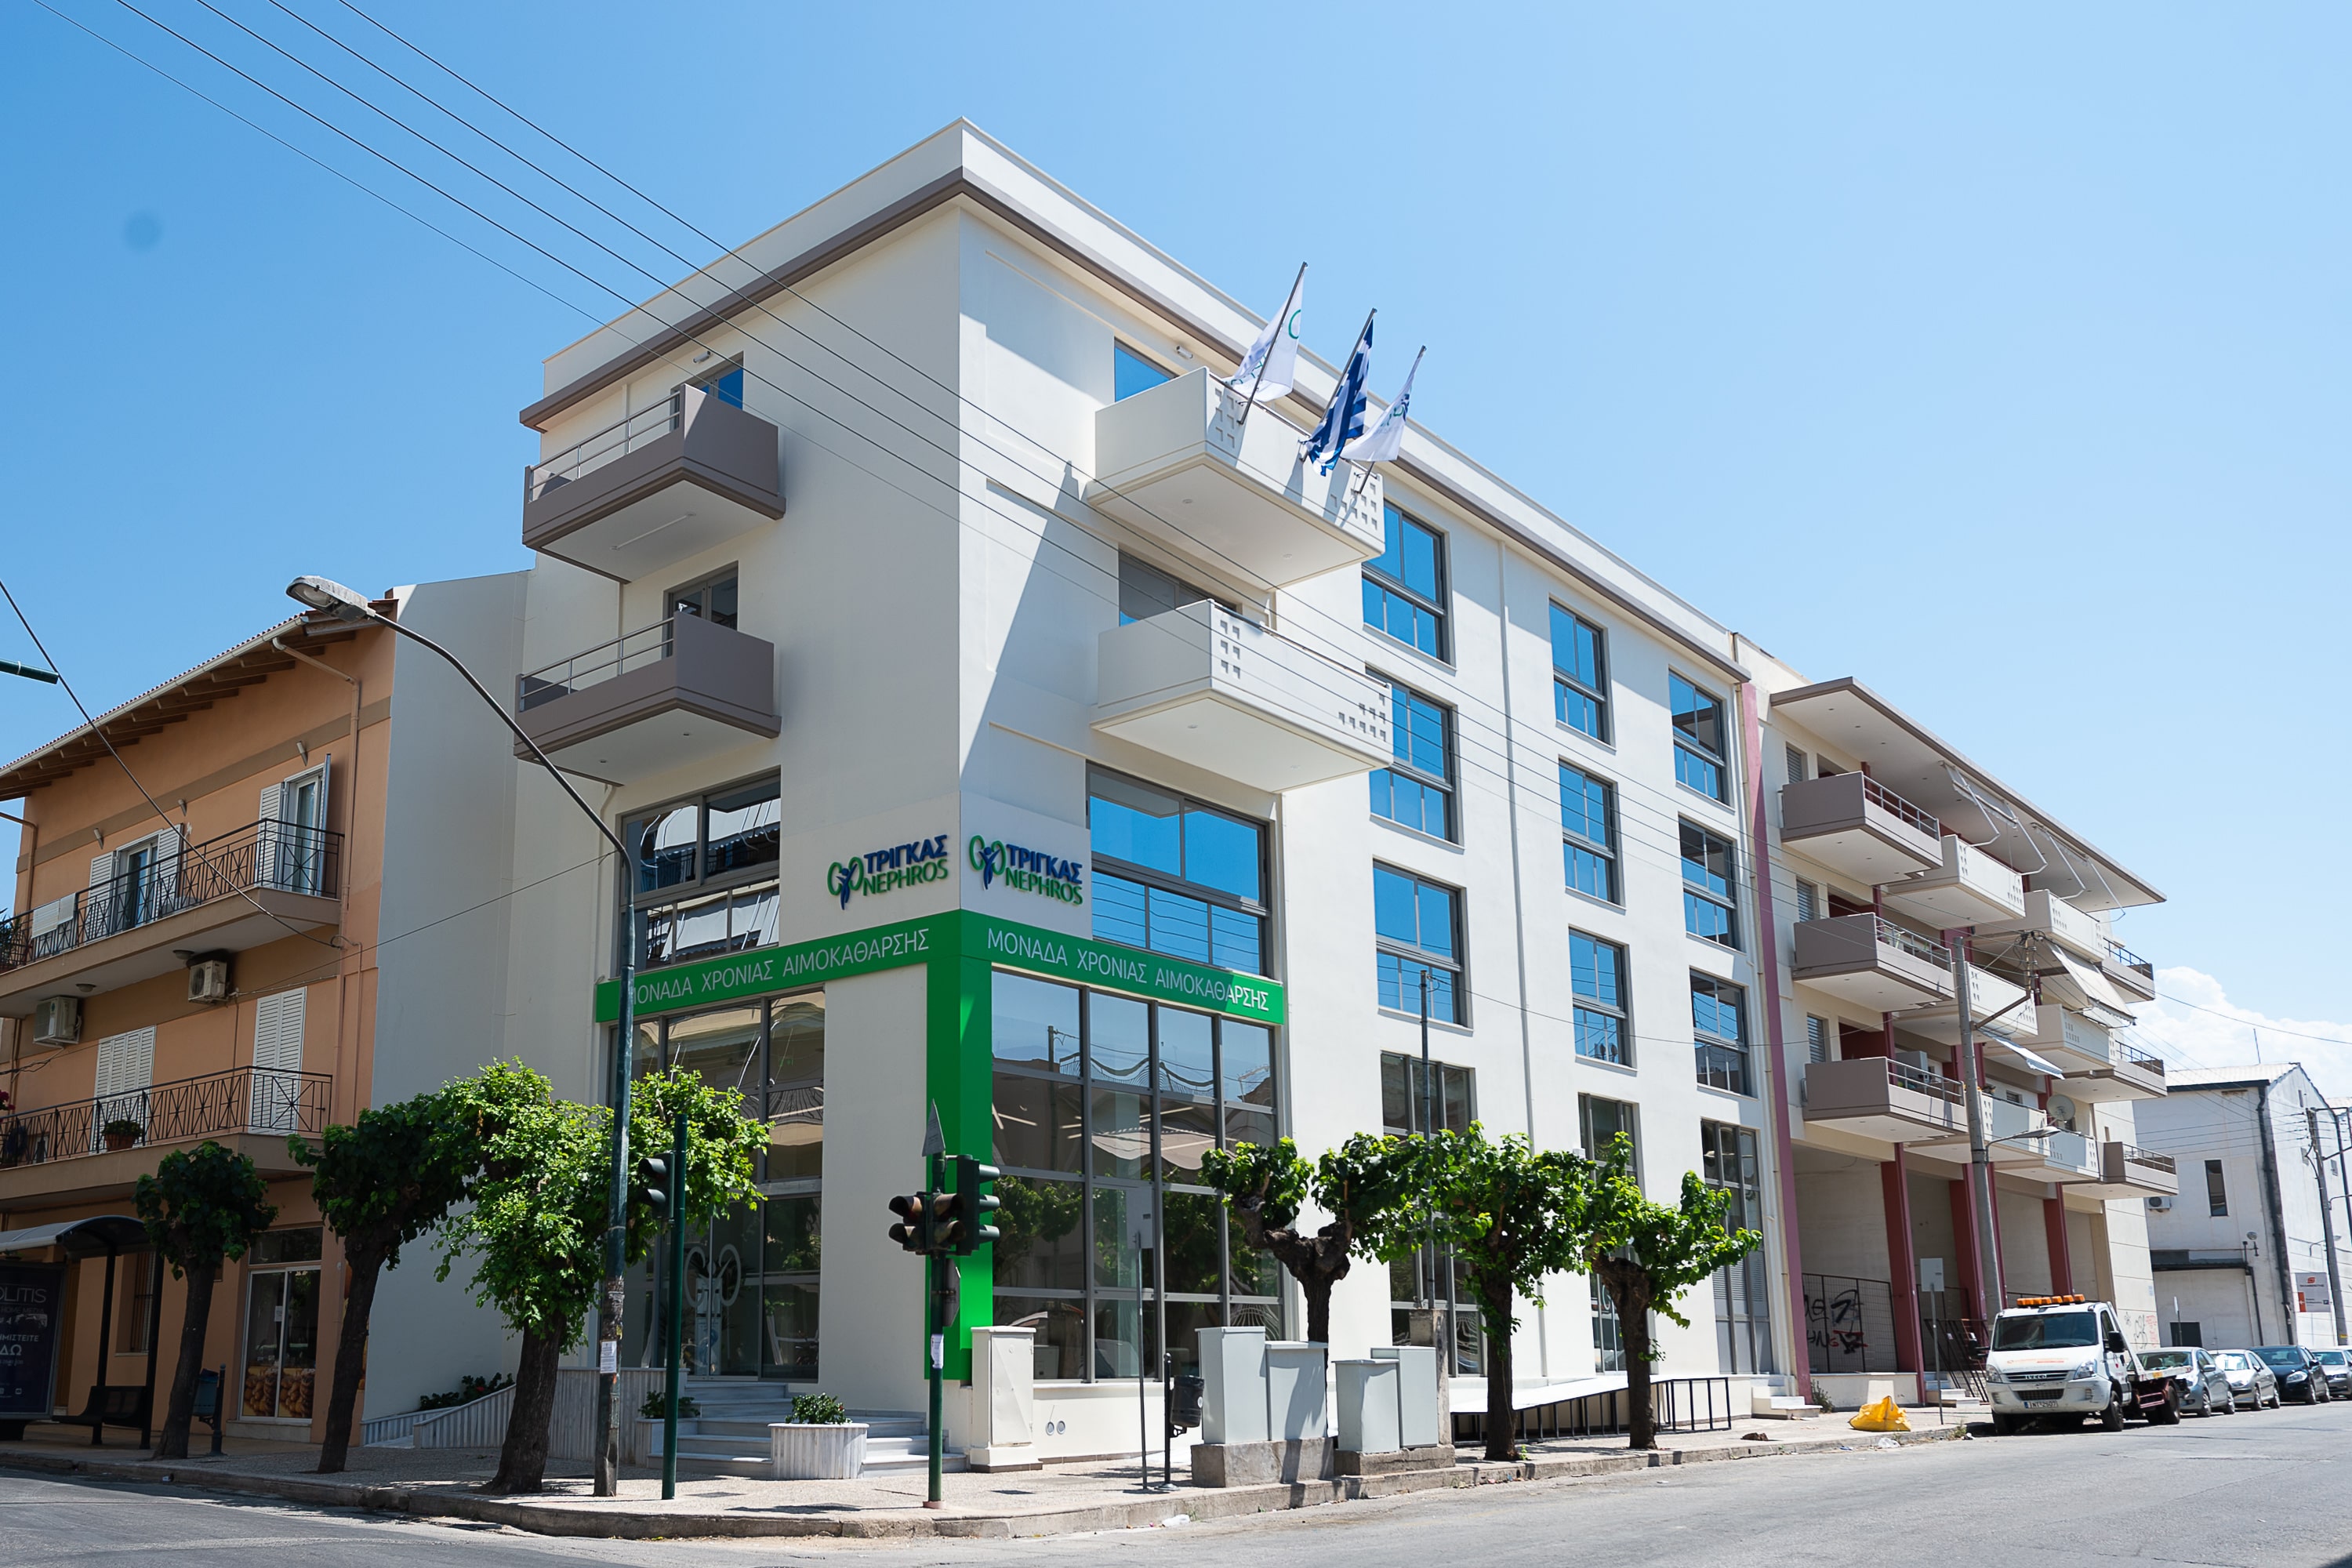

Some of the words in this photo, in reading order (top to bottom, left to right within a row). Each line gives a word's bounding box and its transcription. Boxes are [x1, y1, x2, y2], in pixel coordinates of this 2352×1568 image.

[863, 834, 948, 873] ΤΡΙΓΚΑΣ
[1006, 844, 1083, 884] ΤΡΙΓΚΑΣ
[862, 858, 949, 896] NEPHROS
[1006, 867, 1083, 905] NEPHROS
[633, 977, 692, 1005] ΟΝΑΔΑ
[702, 960, 774, 992] ΧΡΟΝΙΑΣ
[782, 928, 929, 977] ΑΙΜΟΚΑΘΑΡΣΗΣ
[987, 927, 1068, 966] ΜΟΝΑΔΑ
[1076, 948, 1148, 983] ΧΡΟΝΙΑΣ
[1155, 968, 1269, 1011] ΑΙΜΟΚΑΘΑΡΣΗΣ
